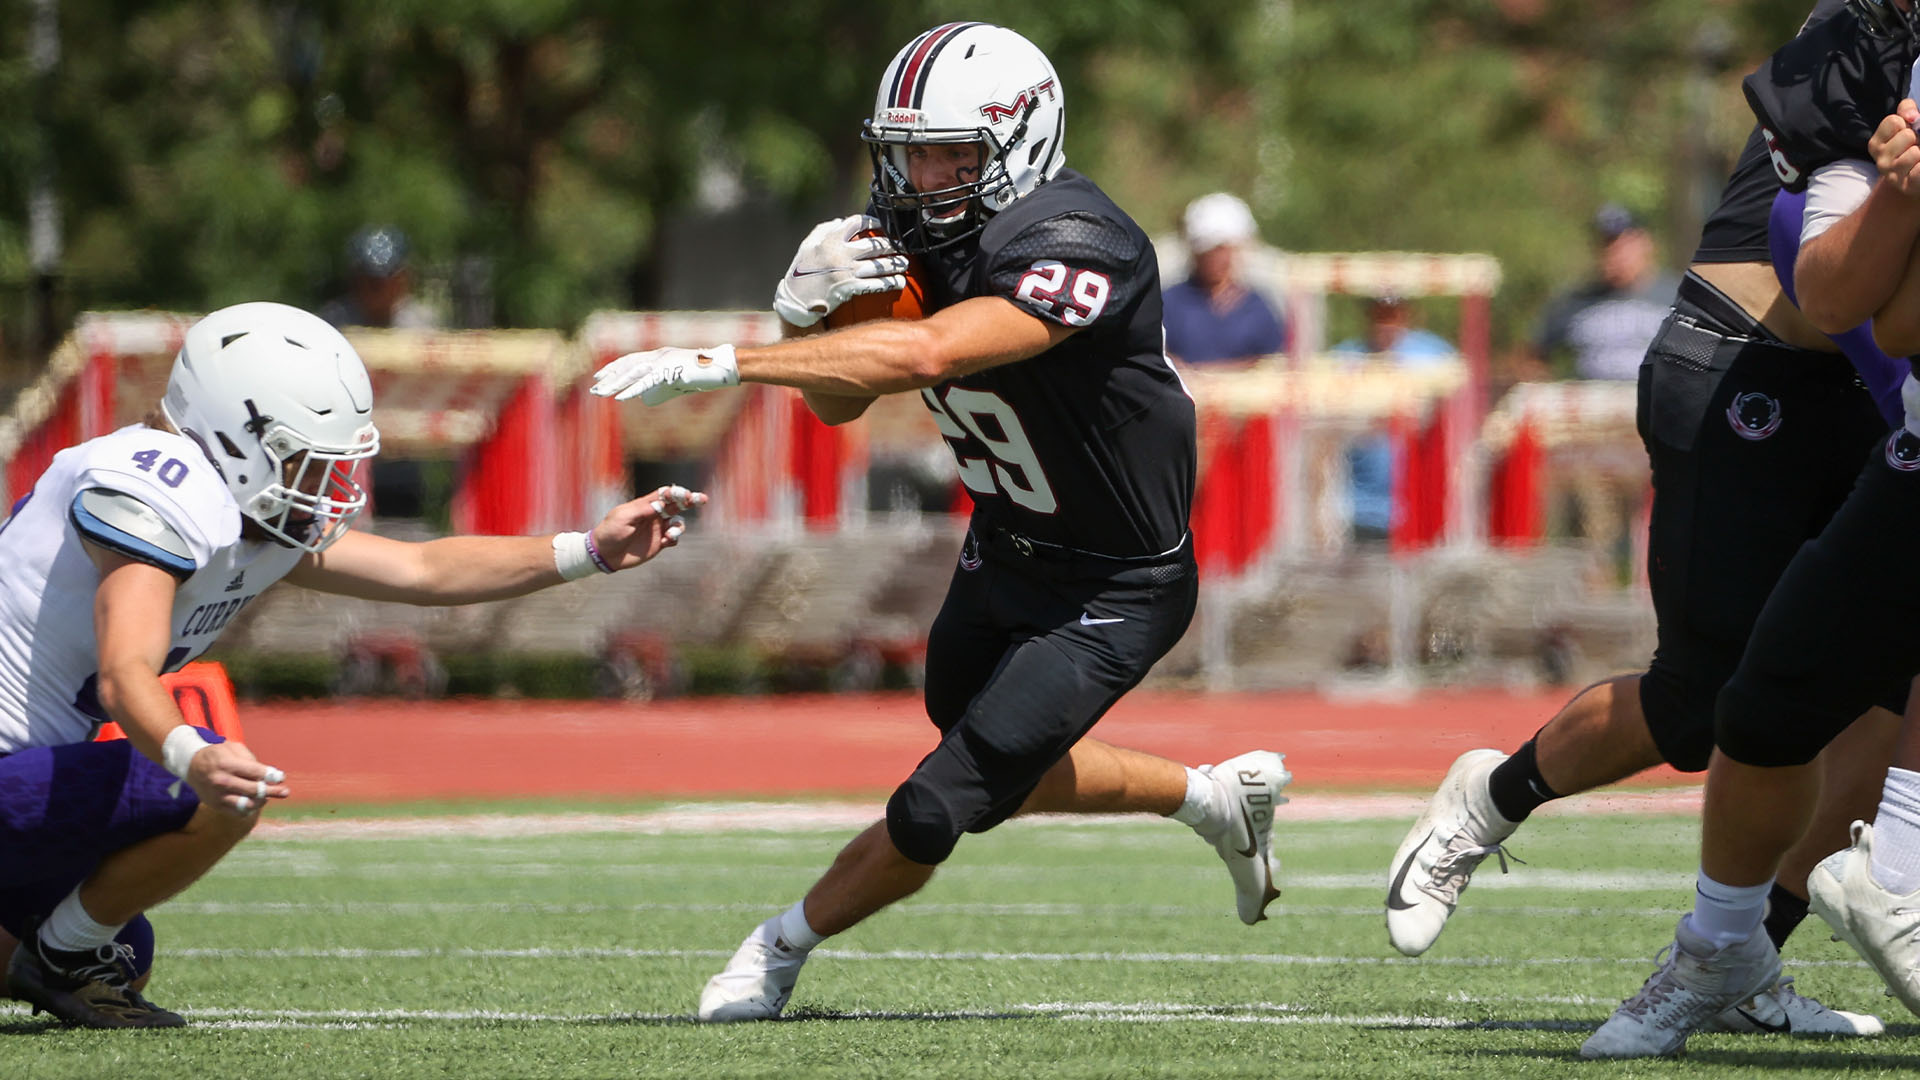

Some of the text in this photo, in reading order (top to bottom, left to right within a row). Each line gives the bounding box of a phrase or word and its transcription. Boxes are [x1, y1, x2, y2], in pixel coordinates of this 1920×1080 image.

[887, 112, 916, 123] Riddell
[1014, 259, 1112, 327] 29
[131, 449, 190, 488] 40
[920, 385, 1060, 516] 29
